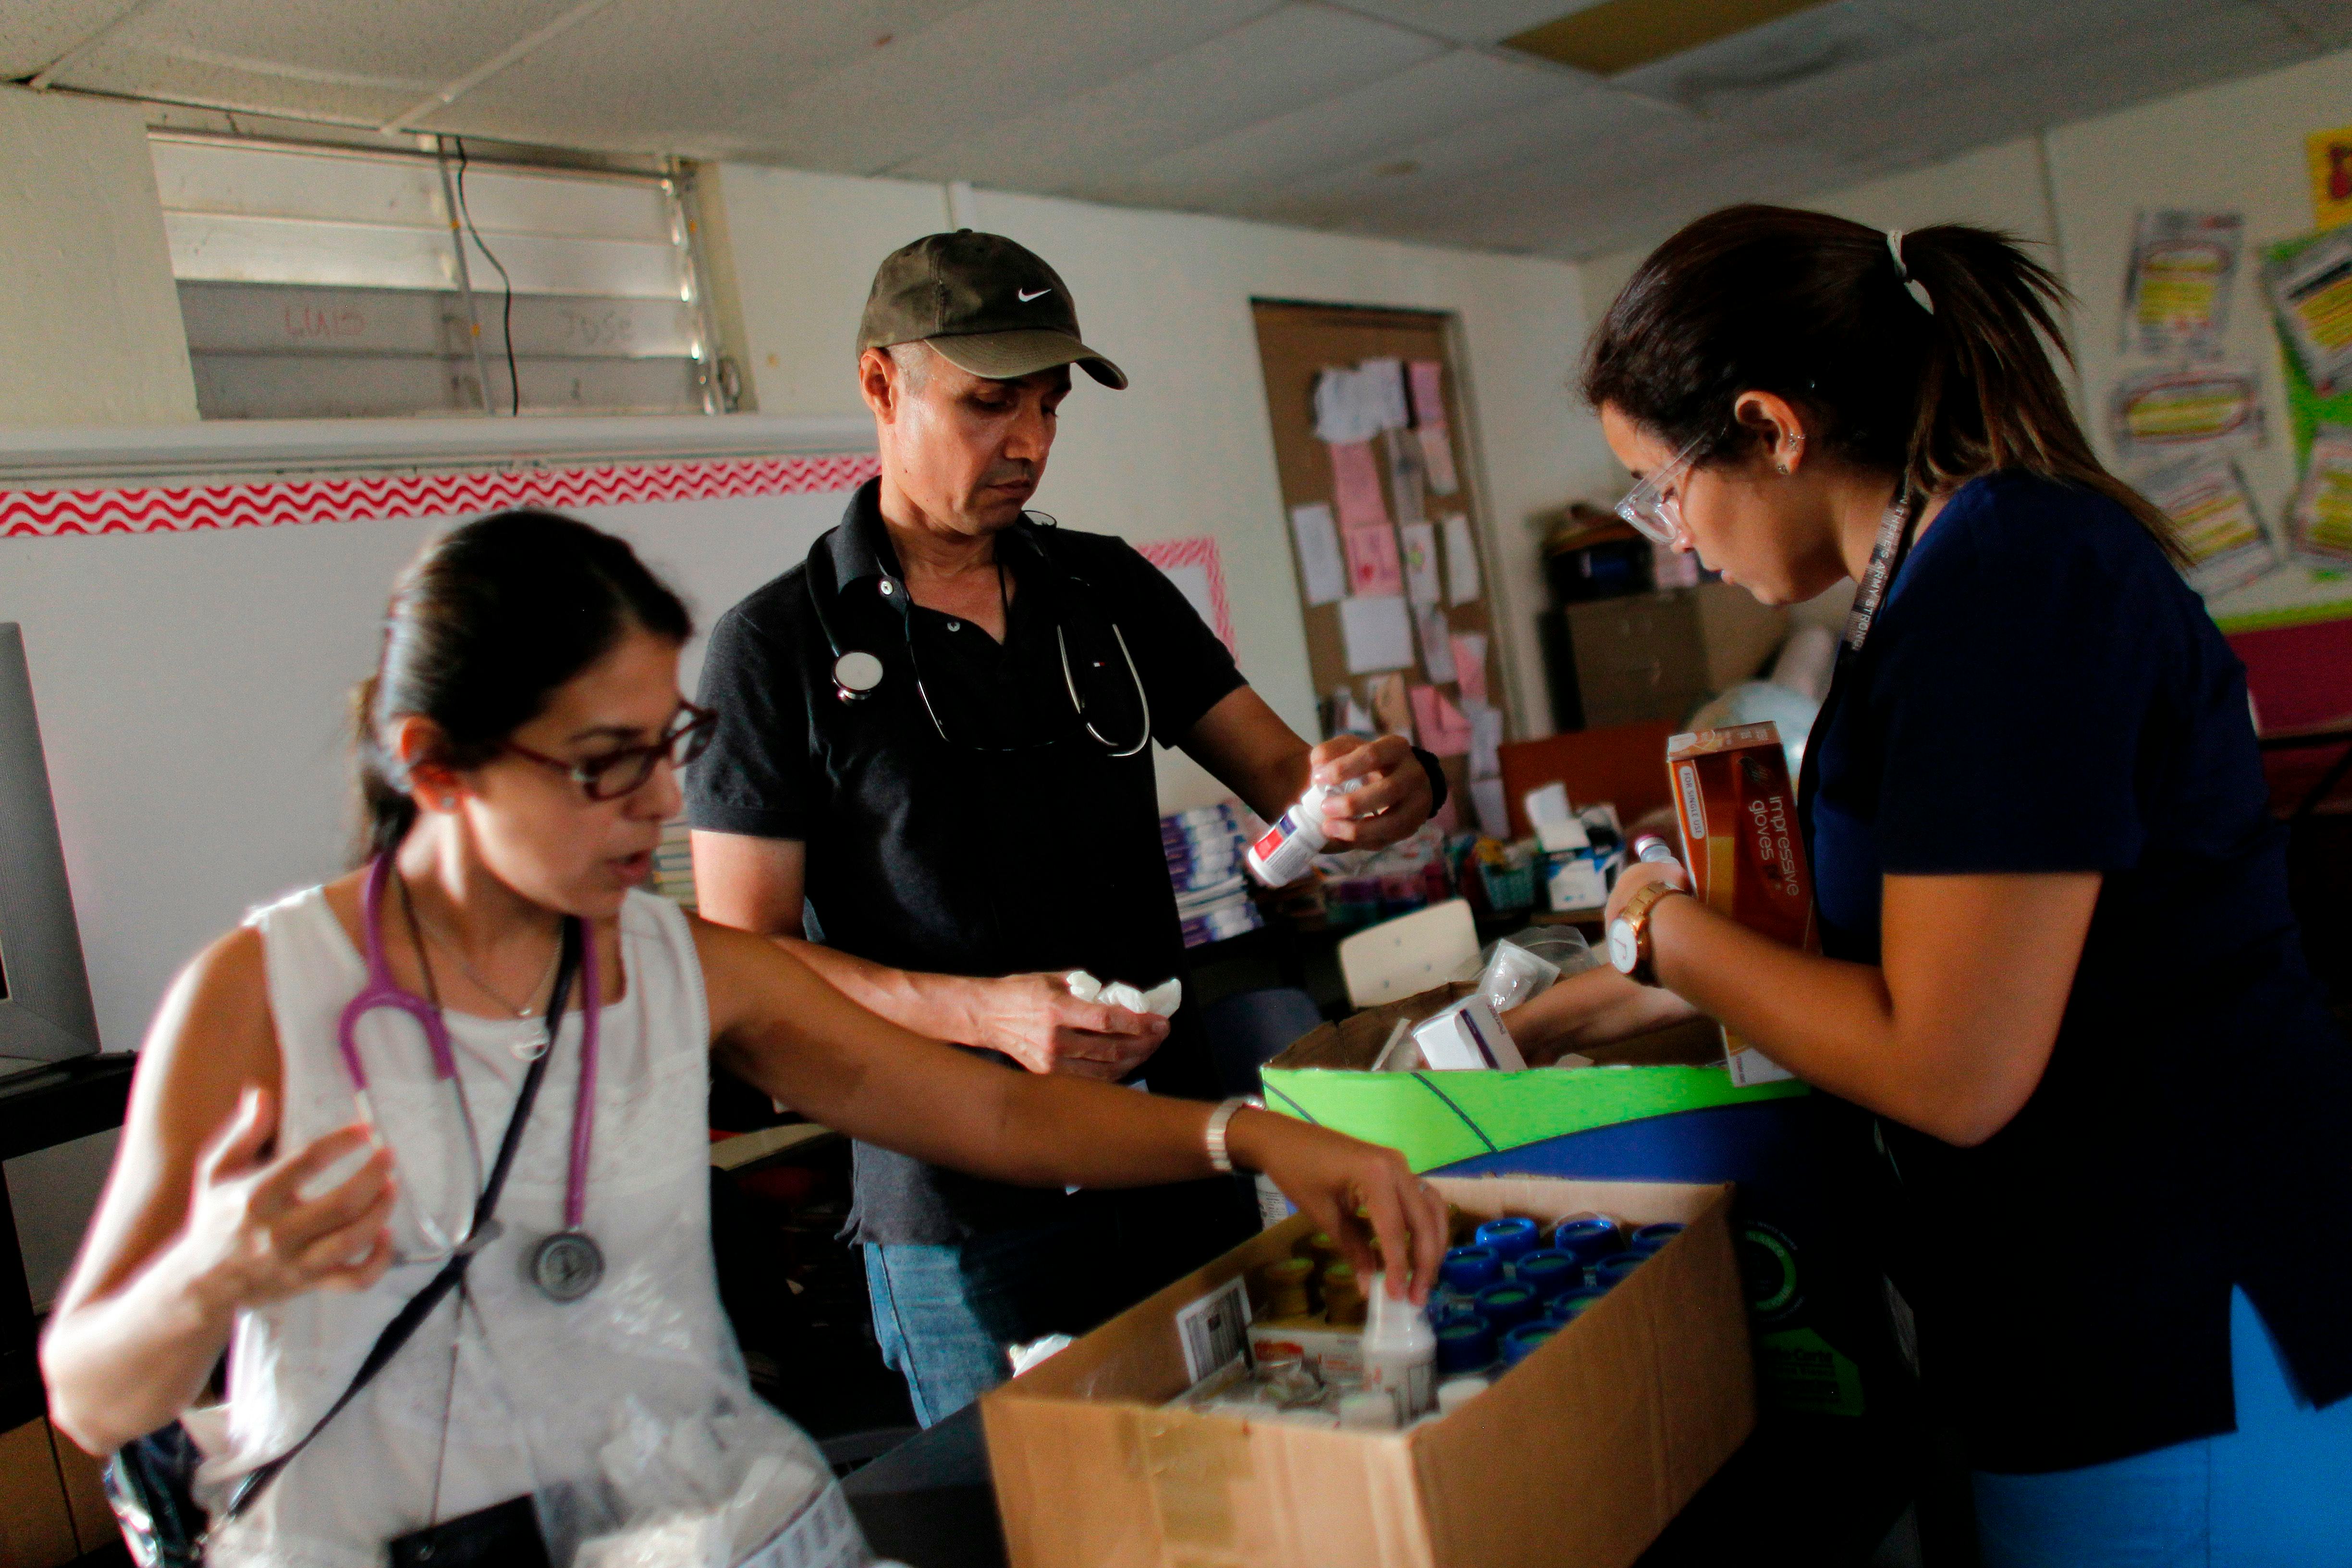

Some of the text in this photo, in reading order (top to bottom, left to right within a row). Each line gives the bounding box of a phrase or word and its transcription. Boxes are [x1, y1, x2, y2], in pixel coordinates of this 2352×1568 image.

[1868, 559, 1888, 596] ARMY
[1852, 597, 1877, 650] STRONG
[1683, 772, 1702, 833] FOR SINGLE USE
[1748, 800, 1775, 860] gloves
